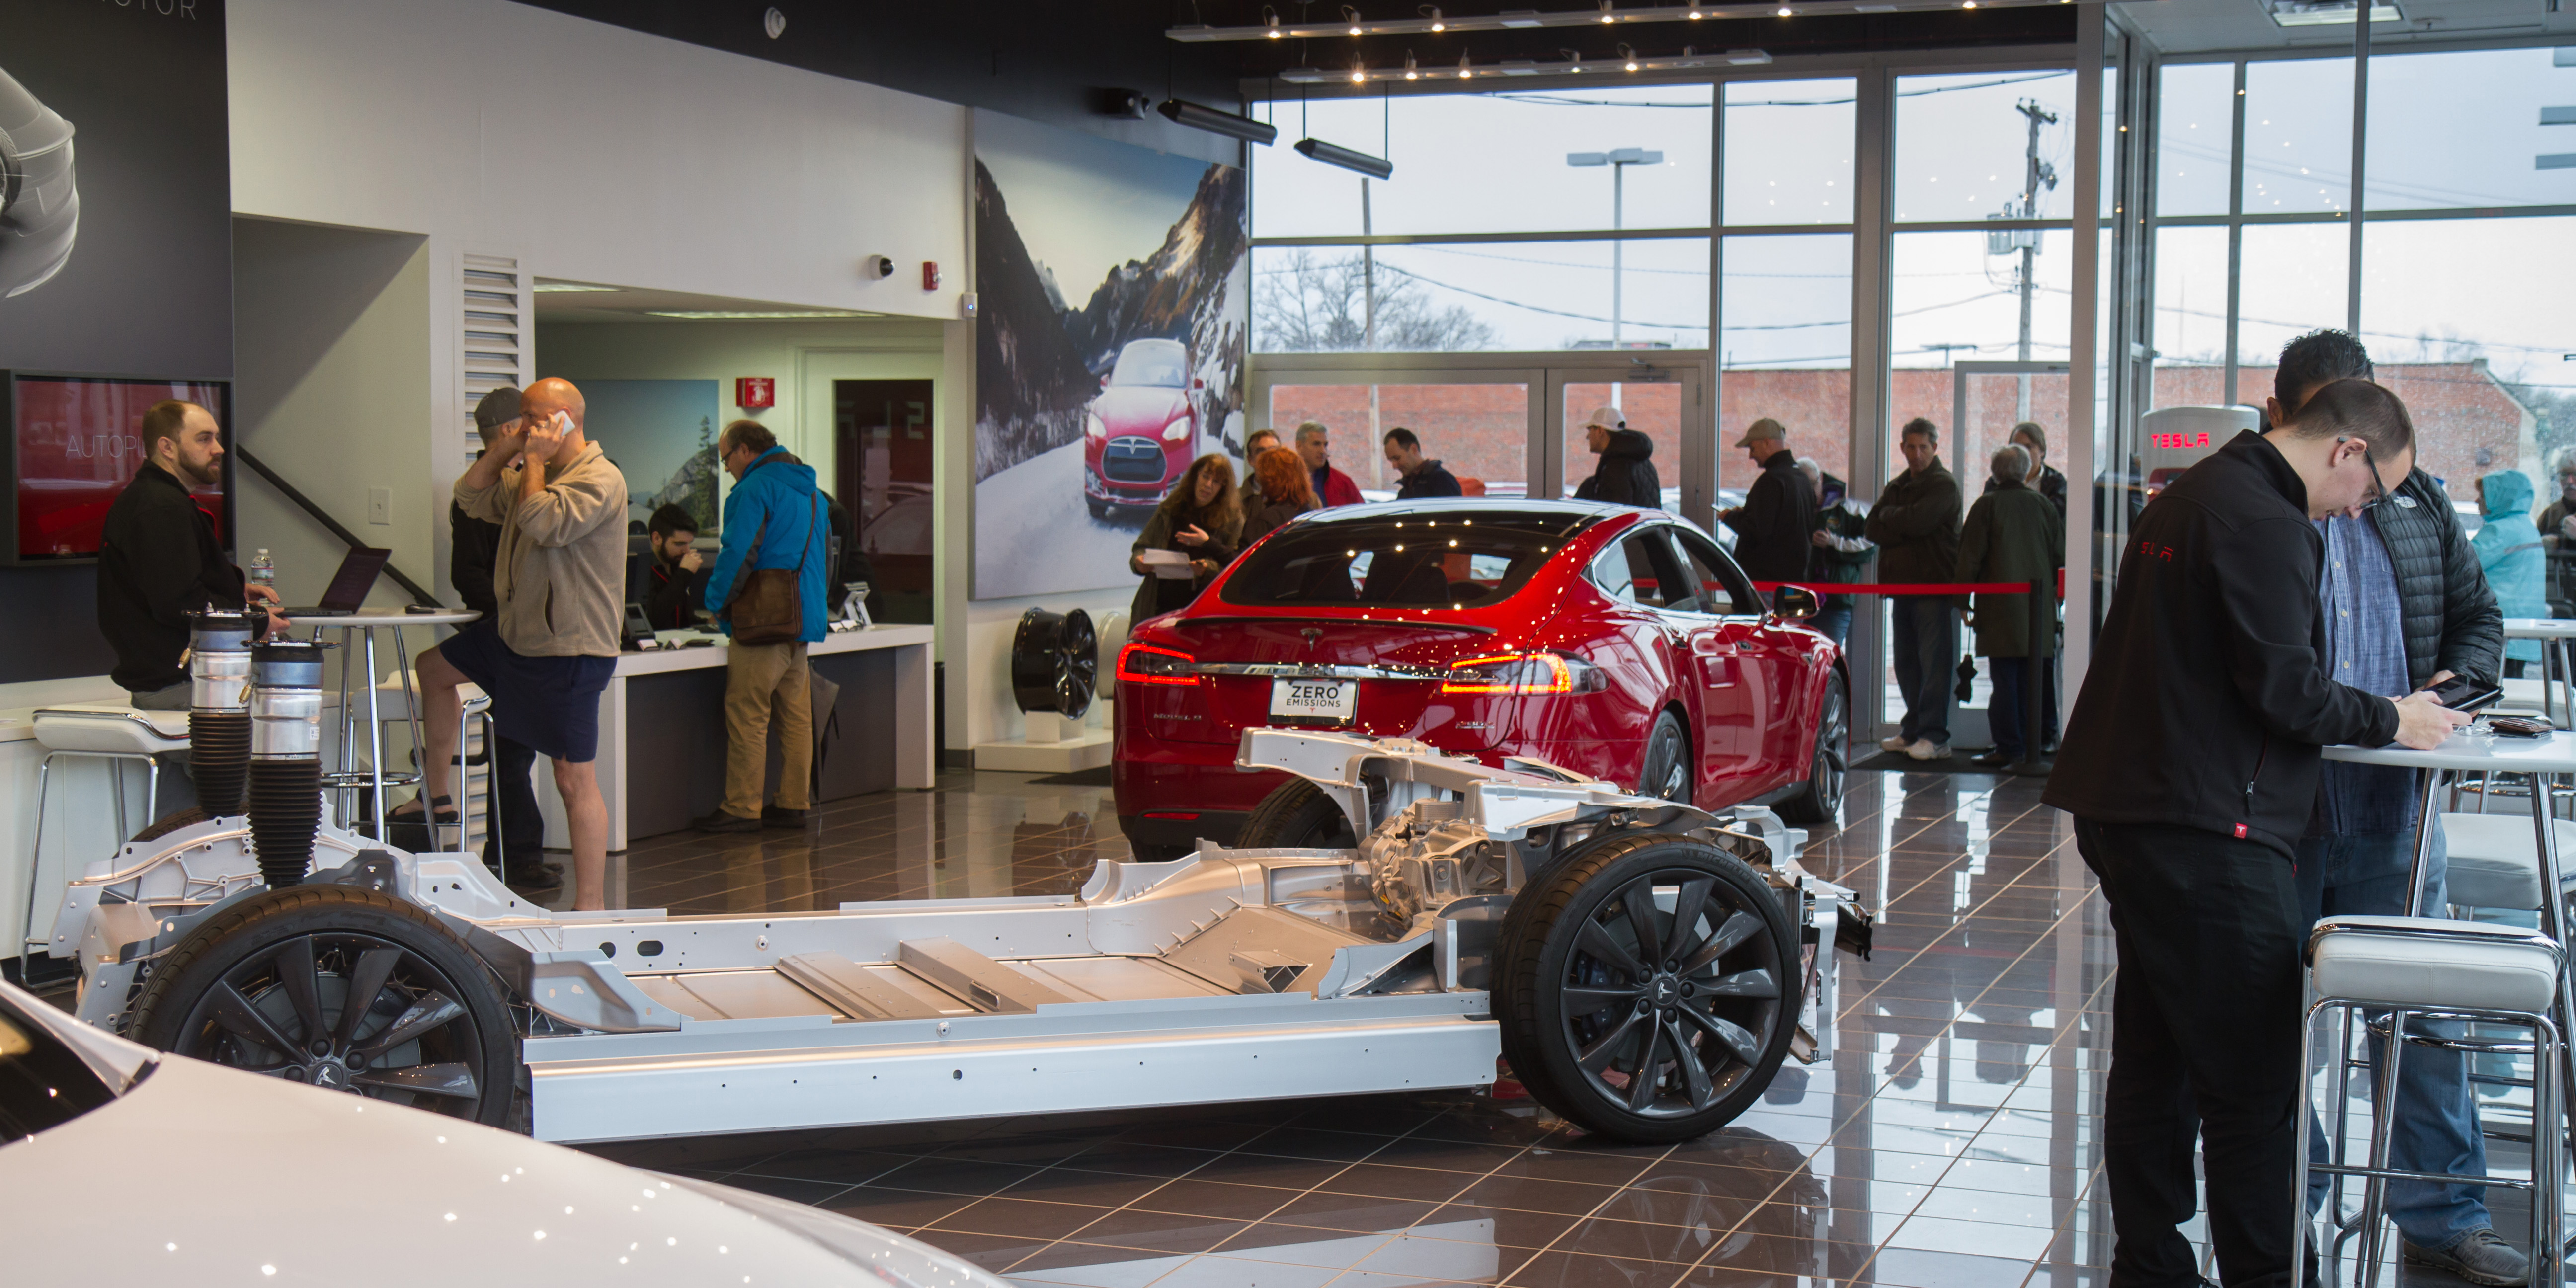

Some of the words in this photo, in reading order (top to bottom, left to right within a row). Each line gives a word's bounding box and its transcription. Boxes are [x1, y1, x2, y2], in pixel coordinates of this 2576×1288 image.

[2151, 433, 2209, 448] TESLA
[2133, 542, 2174, 562] SLA
[1292, 685, 1339, 699] ZERO
[1286, 698, 1341, 708] EMISSIONS
[1697, 850, 1751, 882] MICHELIN
